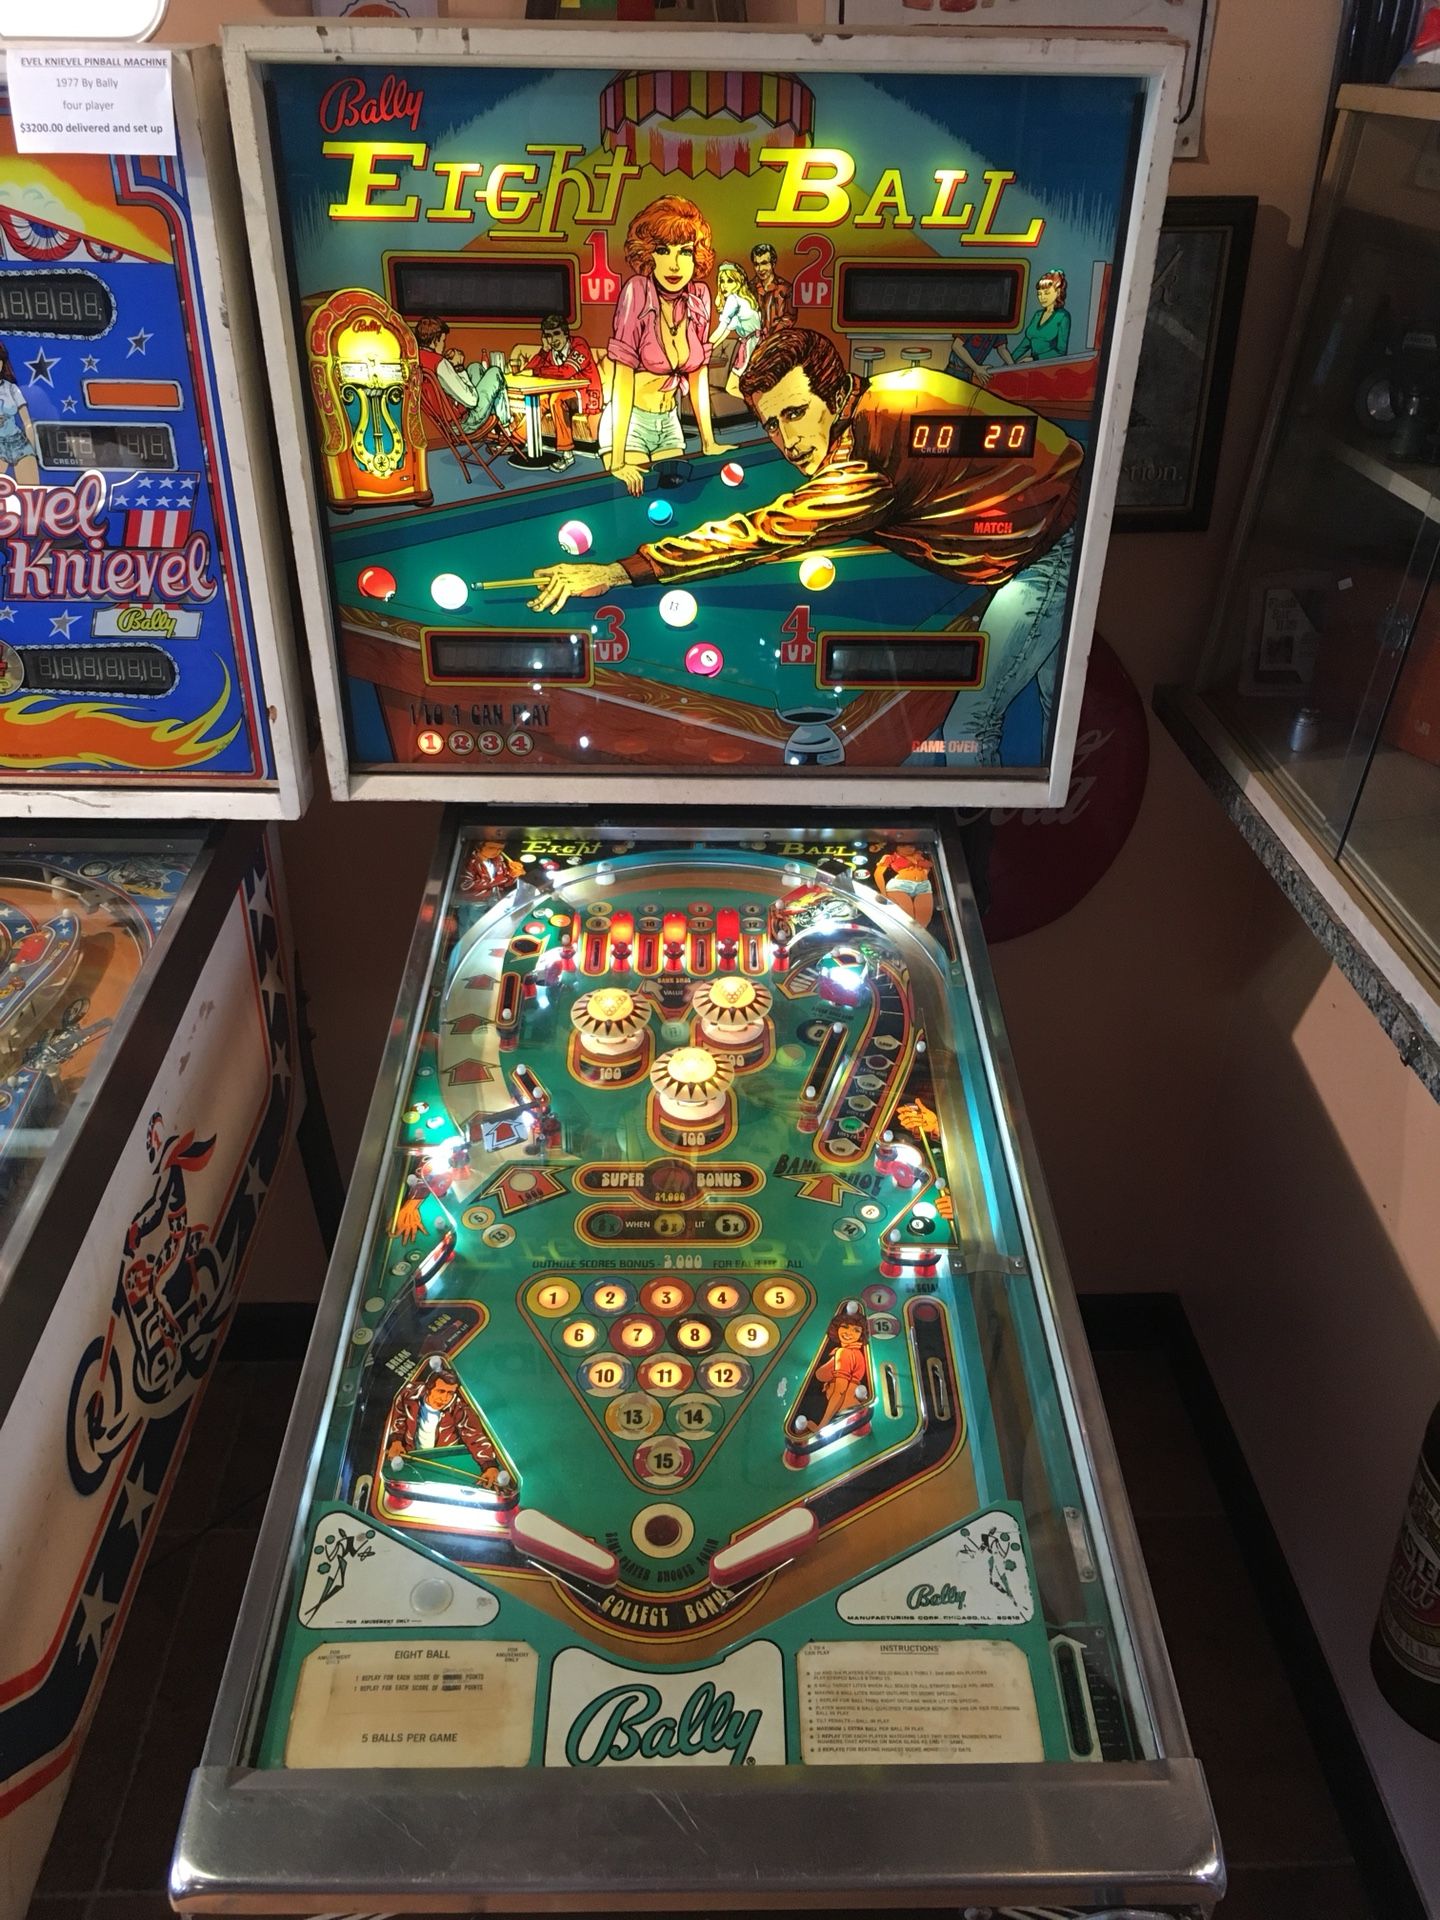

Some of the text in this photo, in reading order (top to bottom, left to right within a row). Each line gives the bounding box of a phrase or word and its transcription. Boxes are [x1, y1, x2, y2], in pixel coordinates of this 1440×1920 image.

[21, 57, 168, 67] EVEL KNIEVEL PINBALL MACHINE
[56, 78, 119, 89] 1977 By Bally
[62, 100, 115, 112] four player
[319, 73, 425, 134] Bally
[20, 123, 163, 135] $3200.00 delivered and set up
[754, 146, 1047, 248] BALL
[587, 279, 616, 300] UP
[799, 283, 829, 305] UP
[984, 425, 1025, 448] 20
[973, 522, 1013, 534] MATCH
[7, 532, 217, 602] Knievel
[117, 607, 177, 638] Bally
[600, 643, 623, 661] UP
[787, 645, 812, 663] UP
[471, 704, 503, 726] CAN
[912, 740, 978, 753] GAME OVER
[777, 841, 857, 856] BALL
[724, 1055, 745, 1066] 00
[600, 1068, 622, 1079] 100
[682, 1133, 706, 1145] 100
[601, 1173, 741, 1187] SUPER BONUS
[843, 1224, 856, 1235] 14
[492, 1231, 507, 1242] 13
[580, 1260, 616, 1268] SCORES
[620, 1260, 655, 1268] BONUS
[713, 1260, 734, 1268] FOR
[876, 1322, 889, 1333] 15
[595, 1369, 733, 1383] 10 11 12
[623, 1410, 704, 1424] 13 14
[654, 1453, 674, 1468] 15
[906, 1584, 967, 1610] Bally
[601, 1587, 736, 1627] COLLECT BONUS
[394, 1650, 450, 1660] EIGHT BALL
[880, 1644, 939, 1653] INSTRUCTIONS
[361, 1674, 381, 1682] REPLAY
[383, 1674, 394, 1682] FOR
[396, 1674, 411, 1682] EACH
[413, 1674, 431, 1682] SCORE
[465, 1673, 485, 1682] POINTS
[360, 1685, 380, 1693] REPLAY
[381, 1685, 393, 1693] FOR
[412, 1684, 429, 1692] SCORE
[464, 1684, 483, 1692] POINTS
[565, 1681, 763, 1767] Bally
[361, 1733, 458, 1743] 5 BALLS PER GAME
